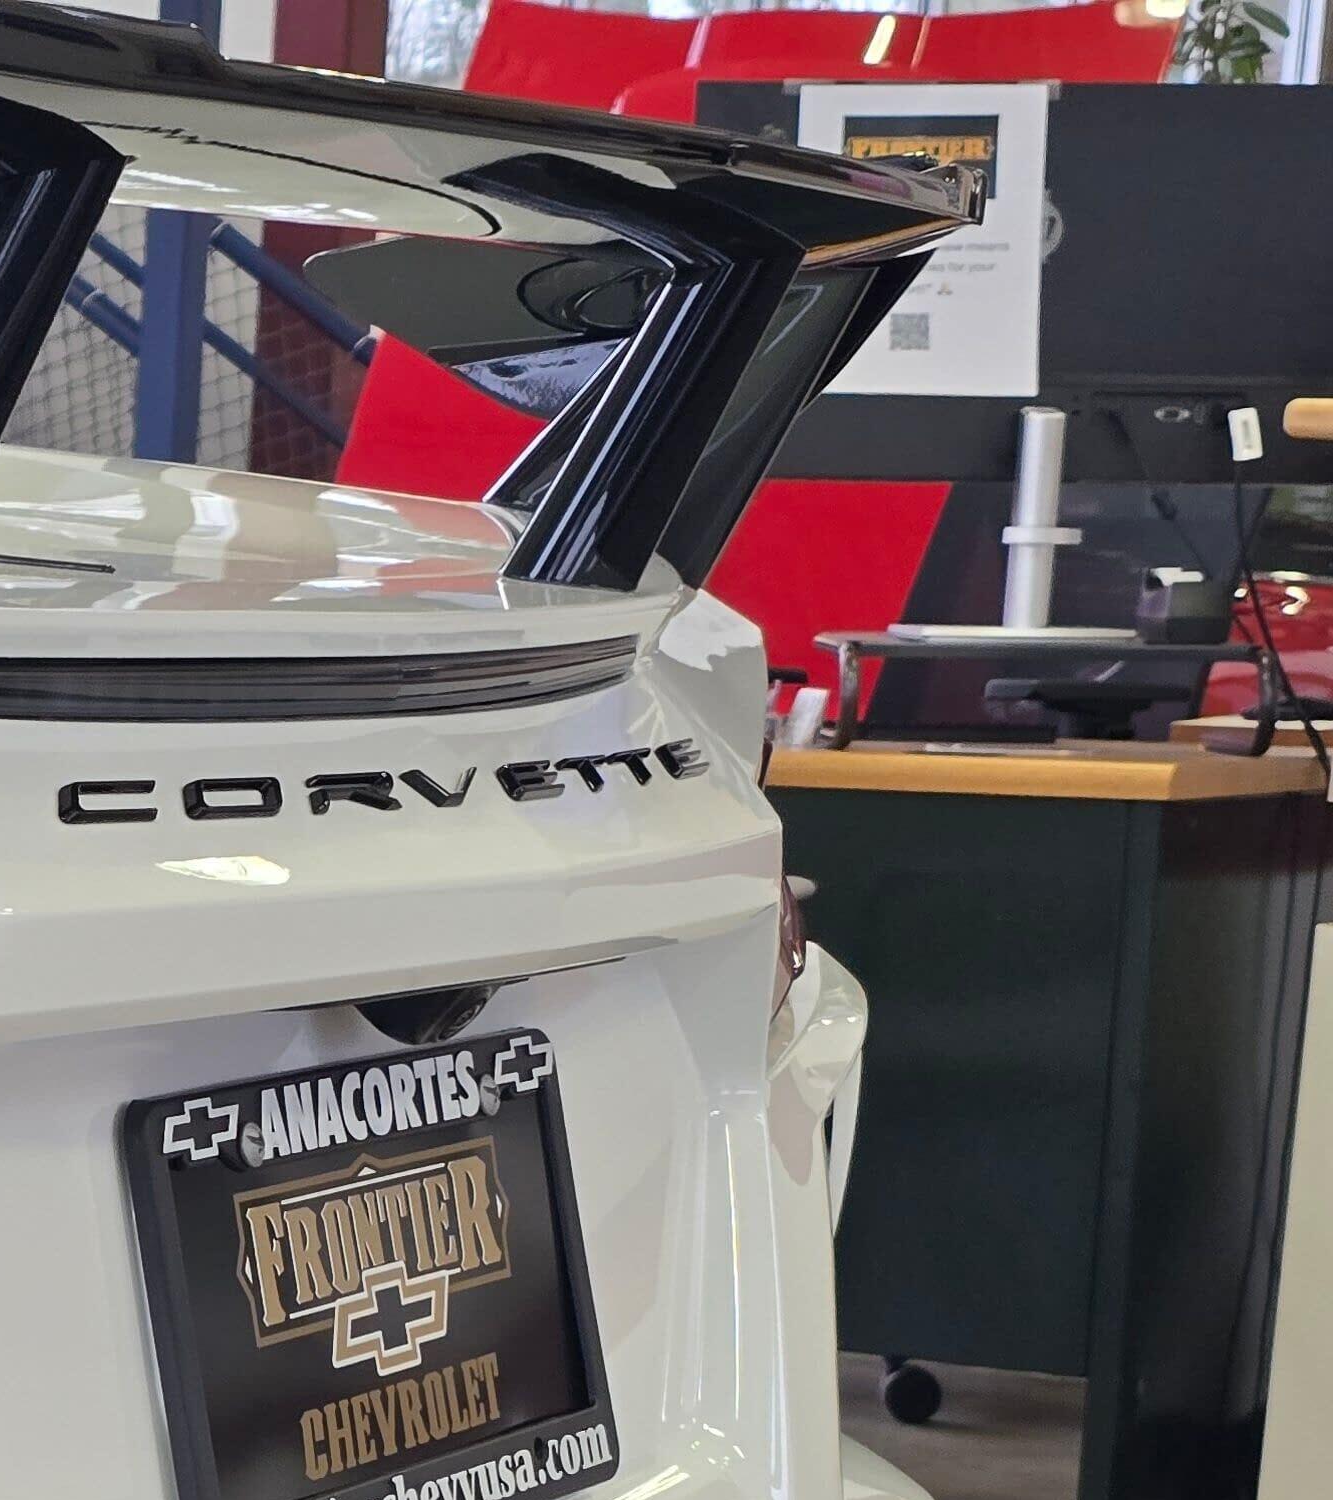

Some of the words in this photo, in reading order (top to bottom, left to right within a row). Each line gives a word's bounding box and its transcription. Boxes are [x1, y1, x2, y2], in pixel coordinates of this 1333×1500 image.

[58, 738, 710, 825] CORVETTE
[260, 1051, 479, 1160] ANACORTES
[244, 1155, 502, 1328] FRONTIER
[300, 1353, 499, 1480] CHEVROLET
